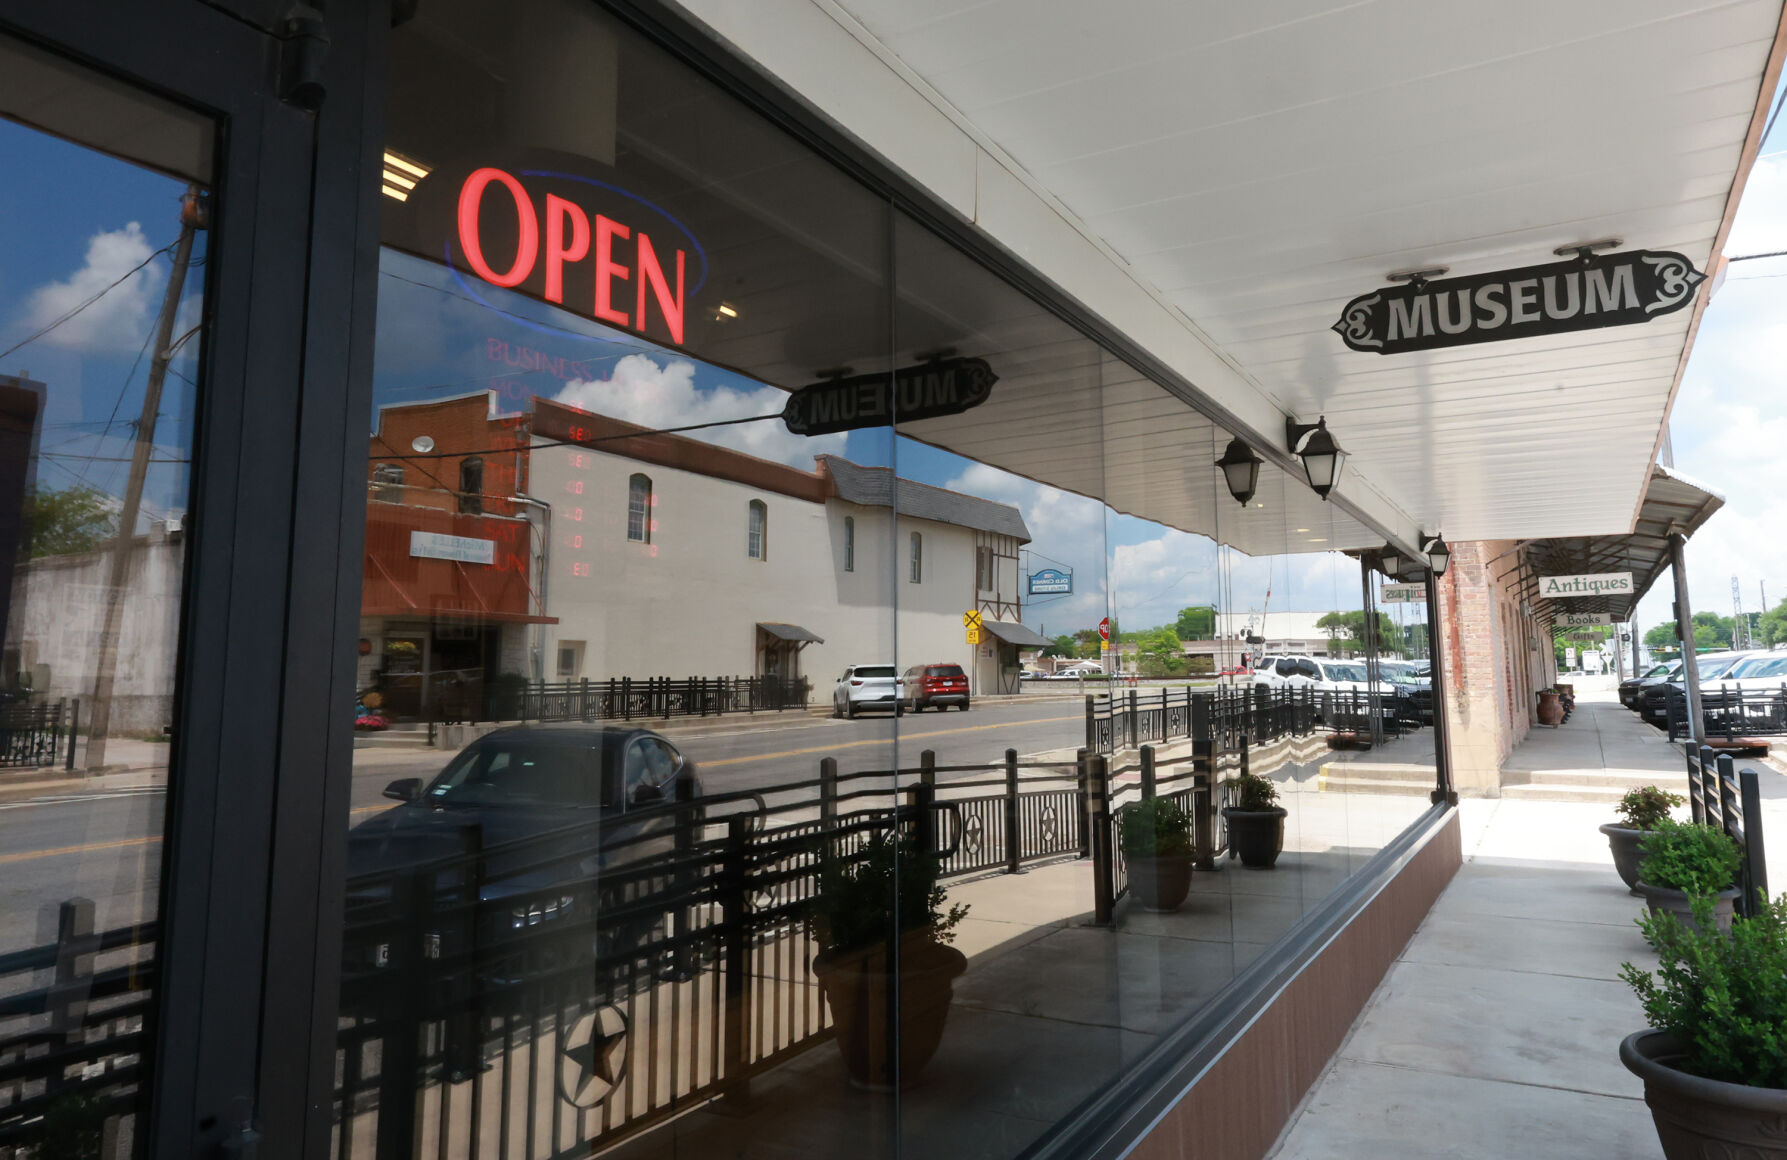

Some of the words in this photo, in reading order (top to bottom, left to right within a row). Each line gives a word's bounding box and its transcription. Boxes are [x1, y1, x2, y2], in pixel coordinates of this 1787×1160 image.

[457, 167, 686, 345] OPEN
[1386, 263, 1641, 341] MUSEUM
[488, 337, 593, 384] BUSINESS
[1546, 577, 1629, 594] Antiques
[1567, 615, 1601, 625] Books
